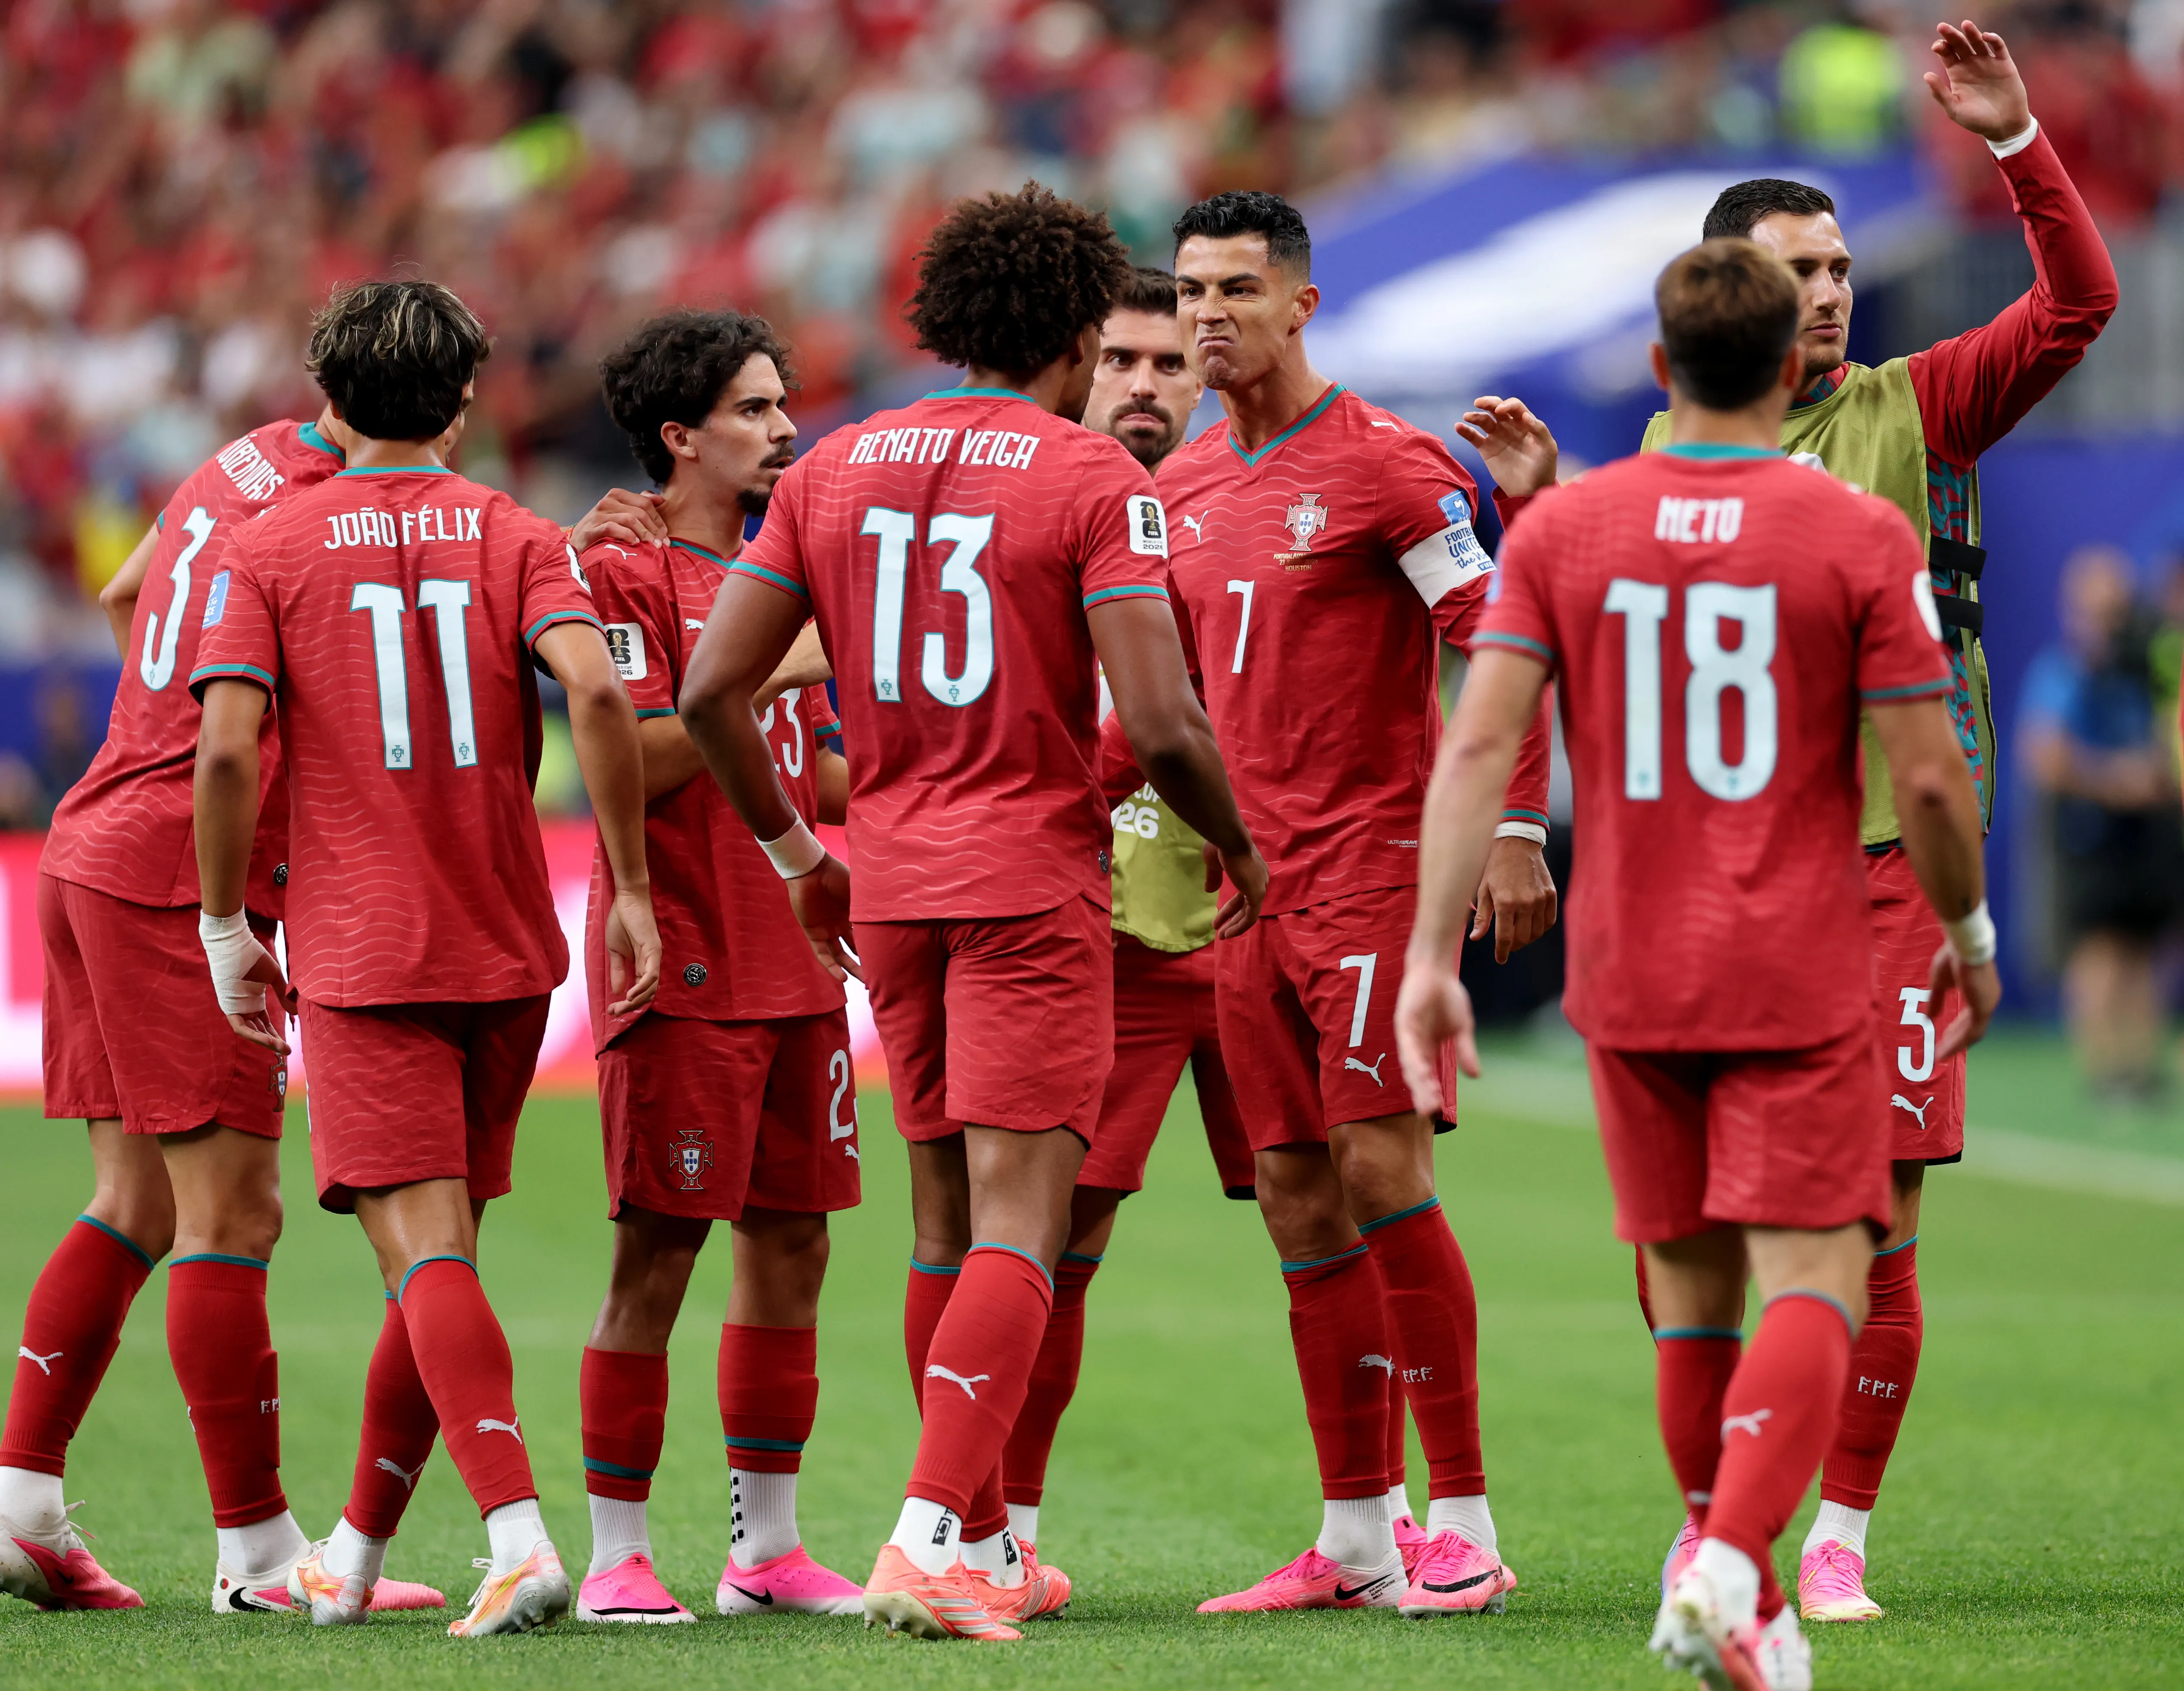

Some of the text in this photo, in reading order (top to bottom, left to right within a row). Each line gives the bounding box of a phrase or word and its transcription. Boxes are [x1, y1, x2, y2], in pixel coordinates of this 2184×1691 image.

[848, 428, 1040, 469] RENATO VEIGA
[324, 504, 482, 550] JOÃO FÉLIX
[1445, 526, 1474, 545] FOOTBA
[1654, 495, 1743, 543] NETO
[140, 506, 218, 691] 3
[1455, 557, 1475, 569] the
[860, 506, 995, 707] 13
[1227, 580, 1255, 674] 7
[349, 579, 478, 770] 11
[1603, 578, 1777, 801] 18
[1340, 952, 1377, 1048] 7
[1898, 987, 1935, 1082] 5
[829, 1042, 859, 1143] 2
[261, 1397, 280, 1414] F.P.
[1403, 1367, 1433, 1383] F.P.F.
[1858, 1376, 1899, 1398] F.P.F.
